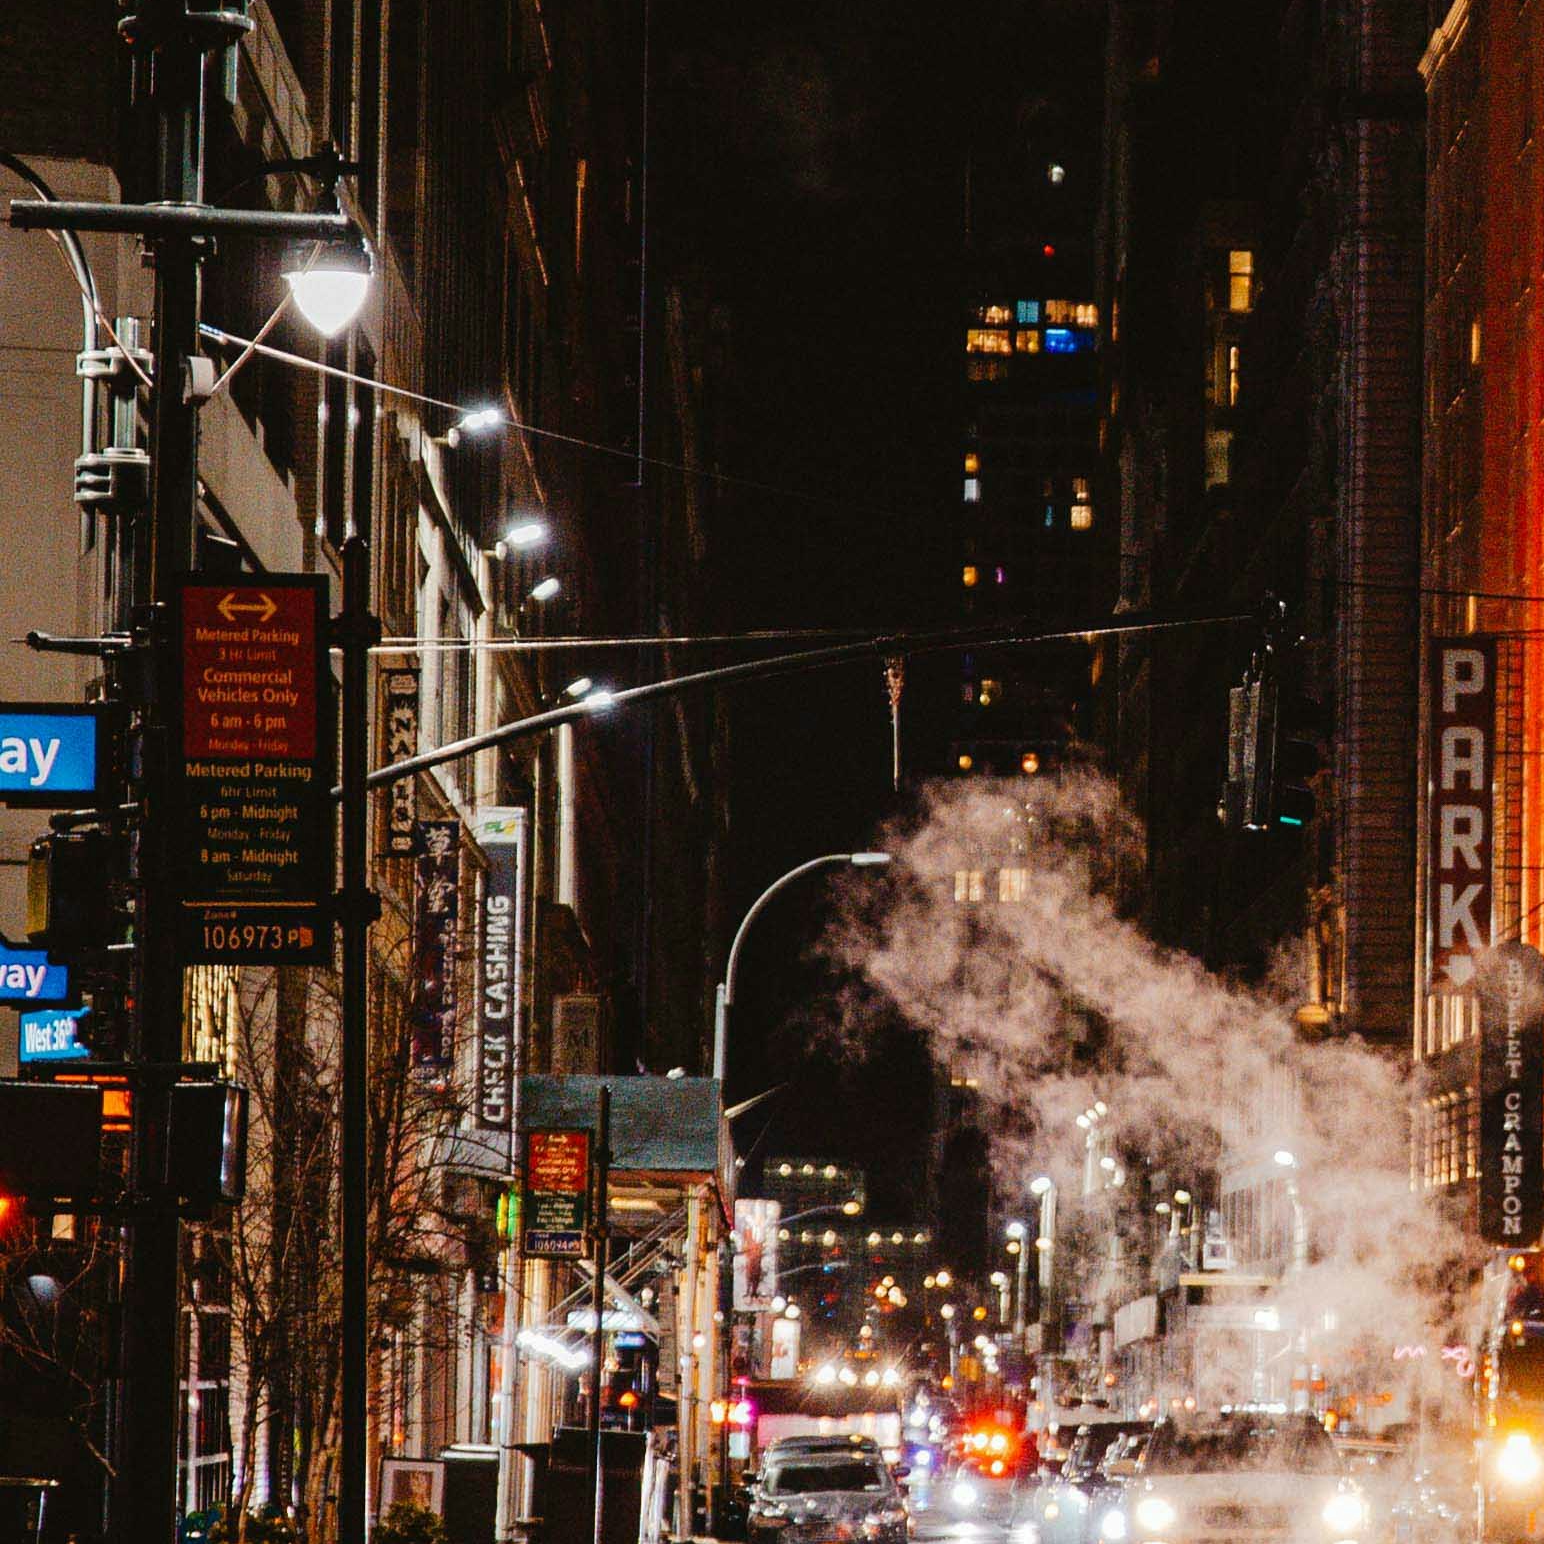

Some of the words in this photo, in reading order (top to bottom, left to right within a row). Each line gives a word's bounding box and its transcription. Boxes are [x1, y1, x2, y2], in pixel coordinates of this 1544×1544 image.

[195, 628, 249, 641] Metered
[252, 628, 299, 646] Parking
[247, 647, 276, 661] Limit
[203, 667, 293, 684] Commercial
[198, 687, 259, 703] Vehicles
[263, 688, 299, 707] Only
[210, 713, 219, 728] 6
[222, 716, 243, 729] am
[253, 713, 262, 729] 6
[265, 716, 287, 732] pm
[208, 738, 249, 753] Monday
[259, 738, 288, 754] Friday
[185, 762, 250, 777] Metered
[255, 762, 312, 782] Parking
[246, 785, 277, 798] Limit
[1440, 648, 1485, 948] PARK
[210, 806, 231, 820] pm
[242, 804, 298, 823] Midnight
[207, 827, 249, 840] Monday
[260, 827, 291, 842] Friday
[201, 848, 209, 863] 8
[211, 852, 231, 863] am
[242, 848, 299, 867] Midnight
[227, 868, 272, 884] Saturday
[204, 925, 282, 950] 106973
[484, 895, 511, 1021] CASHING
[25, 1023, 51, 1053] West
[483, 1033, 506, 1124] CHECK
[1502, 1092, 1522, 1236] CRAMPON
